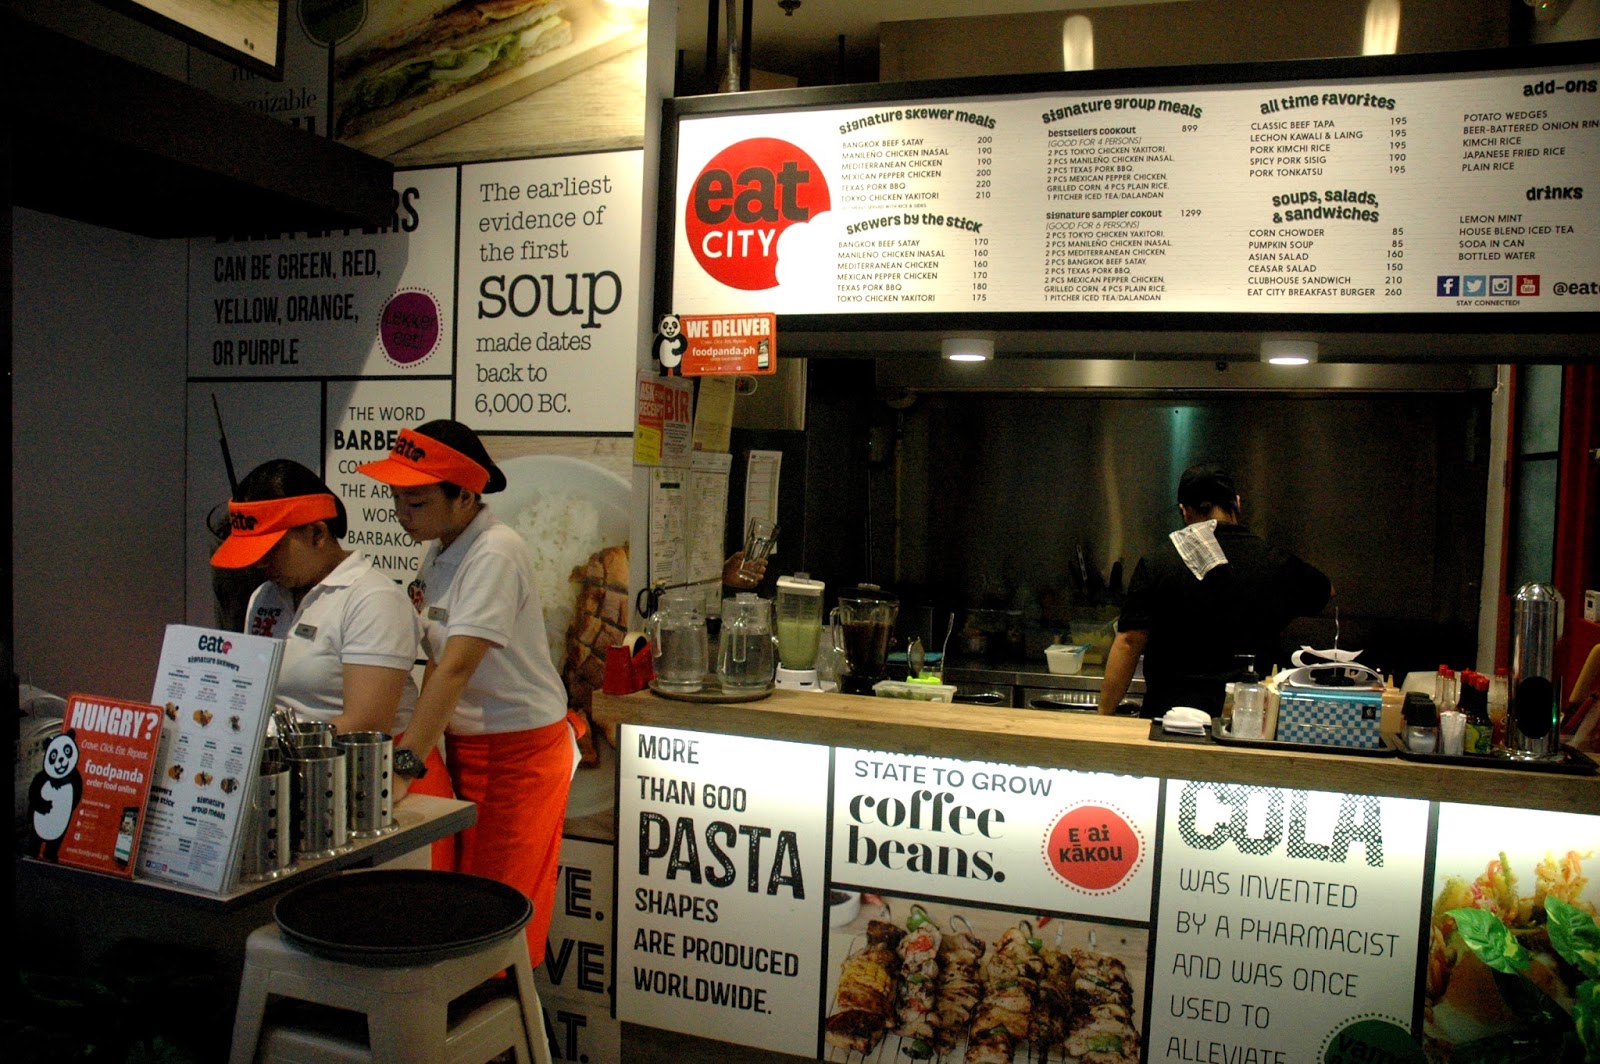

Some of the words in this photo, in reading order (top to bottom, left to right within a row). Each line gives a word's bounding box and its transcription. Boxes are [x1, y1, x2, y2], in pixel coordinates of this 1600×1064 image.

[1523, 79, 1599, 97] add-ons
[1042, 99, 1112, 124] signature
[1115, 98, 1156, 111] group
[1158, 100, 1203, 119] meals
[1260, 99, 1279, 115] all
[1281, 94, 1319, 111] time
[1321, 93, 1396, 110] favorites
[839, 110, 902, 134] signature
[905, 108, 954, 120] skewer
[955, 109, 996, 129] meals
[1251, 122, 1287, 130] CLASSIC
[1290, 121, 1310, 129] BEEF
[1313, 120, 1335, 128] TAPA
[1390, 117, 1407, 125] 195
[1463, 123, 1539, 135] BEER-BATTERED
[1542, 121, 1579, 130] ONION
[1582, 120, 1600, 128] RIN
[1464, 113, 1502, 122] POTATO
[1506, 111, 1548, 120] WEDGES
[1048, 129, 1098, 137] bestsellers
[1100, 127, 1136, 135] cookout
[1250, 134, 1287, 142] LECHON
[1290, 132, 1322, 141] KAWALI
[1325, 132, 1331, 140] &
[1334, 131, 1363, 139] LAING
[843, 141, 879, 149] BANGKOK
[1462, 150, 1509, 159] JAPANESE
[1513, 149, 1539, 157] FRIED
[1543, 147, 1565, 156] RICE
[480, 182, 520, 202] The
[527, 175, 612, 199] earliest
[694, 161, 810, 225] eat
[1272, 191, 1322, 207] soups,
[1325, 189, 1379, 208] salads,
[1526, 186, 1583, 200] drinks
[479, 211, 576, 232] evidence
[583, 206, 606, 225] of
[847, 215, 900, 234] skewers
[904, 214, 919, 225] by
[922, 213, 944, 225] the
[946, 217, 982, 233] stick
[1046, 211, 1090, 220] signature
[1092, 210, 1129, 220] sampler
[1181, 209, 1202, 217] 1299
[1273, 213, 1283, 224] &
[1285, 206, 1380, 223] sandwiches
[1459, 227, 1492, 236] HOUSE
[1495, 227, 1525, 235] BLEND
[1528, 226, 1552, 234] ICED
[1555, 226, 1574, 234] TEA
[480, 243, 514, 261] the
[520, 239, 569, 260] first
[702, 228, 776, 259] CITY
[214, 255, 246, 282] CAN
[251, 254, 271, 280] BE
[277, 251, 337, 279] GREEN,
[342, 249, 381, 278] RED,
[478, 270, 622, 329] soup
[1289, 288, 1337, 296] BREAKFAST
[1341, 288, 1375, 296] BURGER
[214, 297, 282, 325] YELLOW,
[287, 294, 359, 323] ORANGE,
[686, 321, 709, 338] WE
[712, 318, 770, 337] DELIVER
[213, 340, 233, 365] OR
[238, 339, 299, 365] PURPLE
[476, 333, 531, 352] made
[536, 331, 591, 351] dates
[692, 346, 755, 357] foodpanda.ph
[476, 363, 522, 382] back
[528, 366, 547, 381] to
[349, 407, 374, 420] THE
[379, 407, 425, 420] WORD
[475, 393, 533, 417] 6,000
[538, 393, 571, 413] BC.
[665, 387, 689, 423] BIR
[334, 430, 398, 450] BARBE
[341, 484, 365, 498] THE
[363, 508, 400, 523] WOR
[198, 634, 224, 654] eat
[188, 656, 216, 664] signature
[216, 658, 240, 671] skewers
[70, 701, 159, 740] HUNGRY?
[638, 733, 699, 764] MORE
[85, 760, 144, 784] foodpanda
[854, 760, 926, 784] STATE
[933, 768, 965, 787] TO
[971, 772, 1052, 797] GROW
[86, 779, 102, 788] order
[104, 782, 117, 791] food
[118, 784, 136, 795] online
[637, 775, 695, 806] THAN
[703, 784, 747, 812] 600
[849, 789, 1006, 839] coffee
[638, 811, 805, 900] PASTA
[845, 824, 1006, 883] beans.
[1179, 868, 1230, 894] WAS
[1240, 874, 1358, 908] INVENTED
[635, 888, 719, 923] SHAPES
[1176, 910, 1206, 935] BY
[1215, 916, 1230, 938] A
[1240, 917, 1399, 958] PHARMACIST
[634, 927, 675, 956] ARE
[683, 935, 799, 977] PRODUCED
[1172, 954, 1221, 980] AND
[1231, 960, 1282, 987] WAS
[1293, 968, 1358, 997] ONCE
[634, 966, 772, 1015] WORLDWIDE.
[1170, 995, 1231, 1024] USED
[1242, 1004, 1270, 1029] TO
